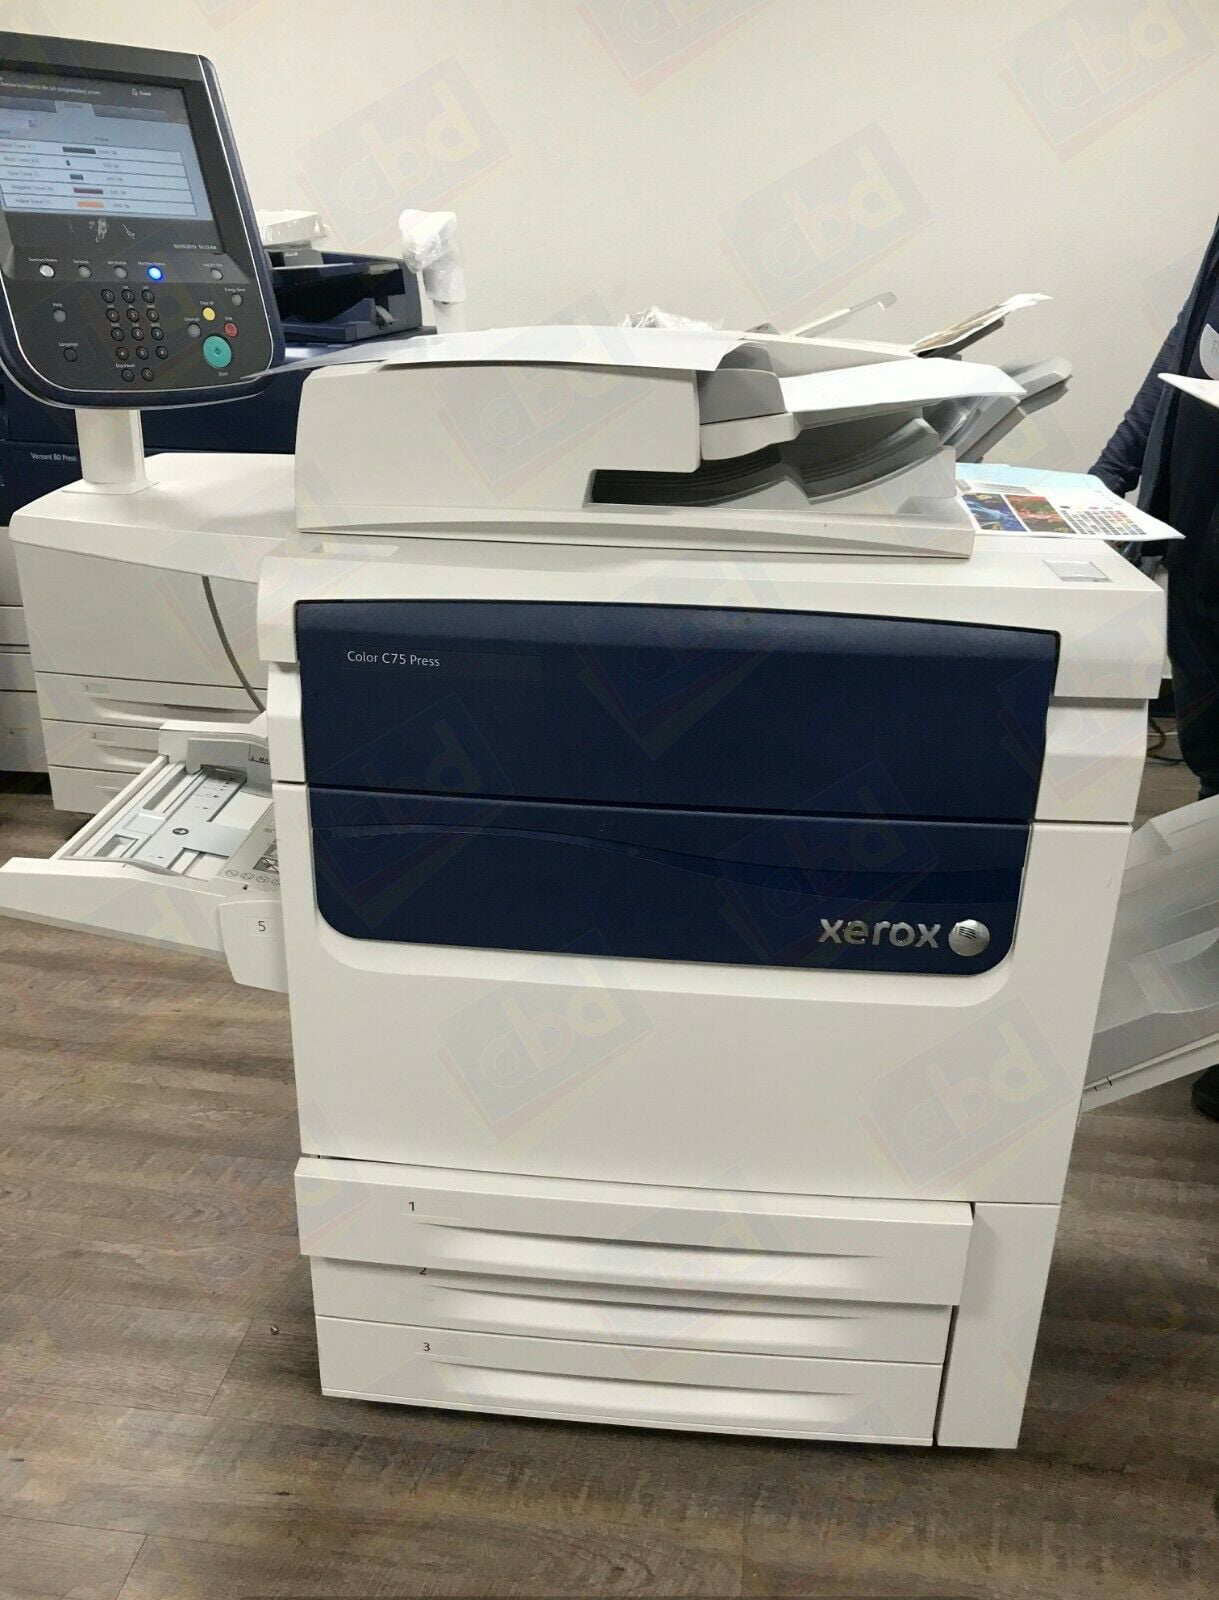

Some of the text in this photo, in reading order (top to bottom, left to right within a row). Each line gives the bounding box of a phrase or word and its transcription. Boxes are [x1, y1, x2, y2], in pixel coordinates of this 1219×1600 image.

[347, 650, 440, 667] Color C75 Press
[258, 920, 266, 932] 5
[818, 918, 941, 948] xerox
[408, 1201, 414, 1212] 1
[424, 1342, 431, 1352] 3
